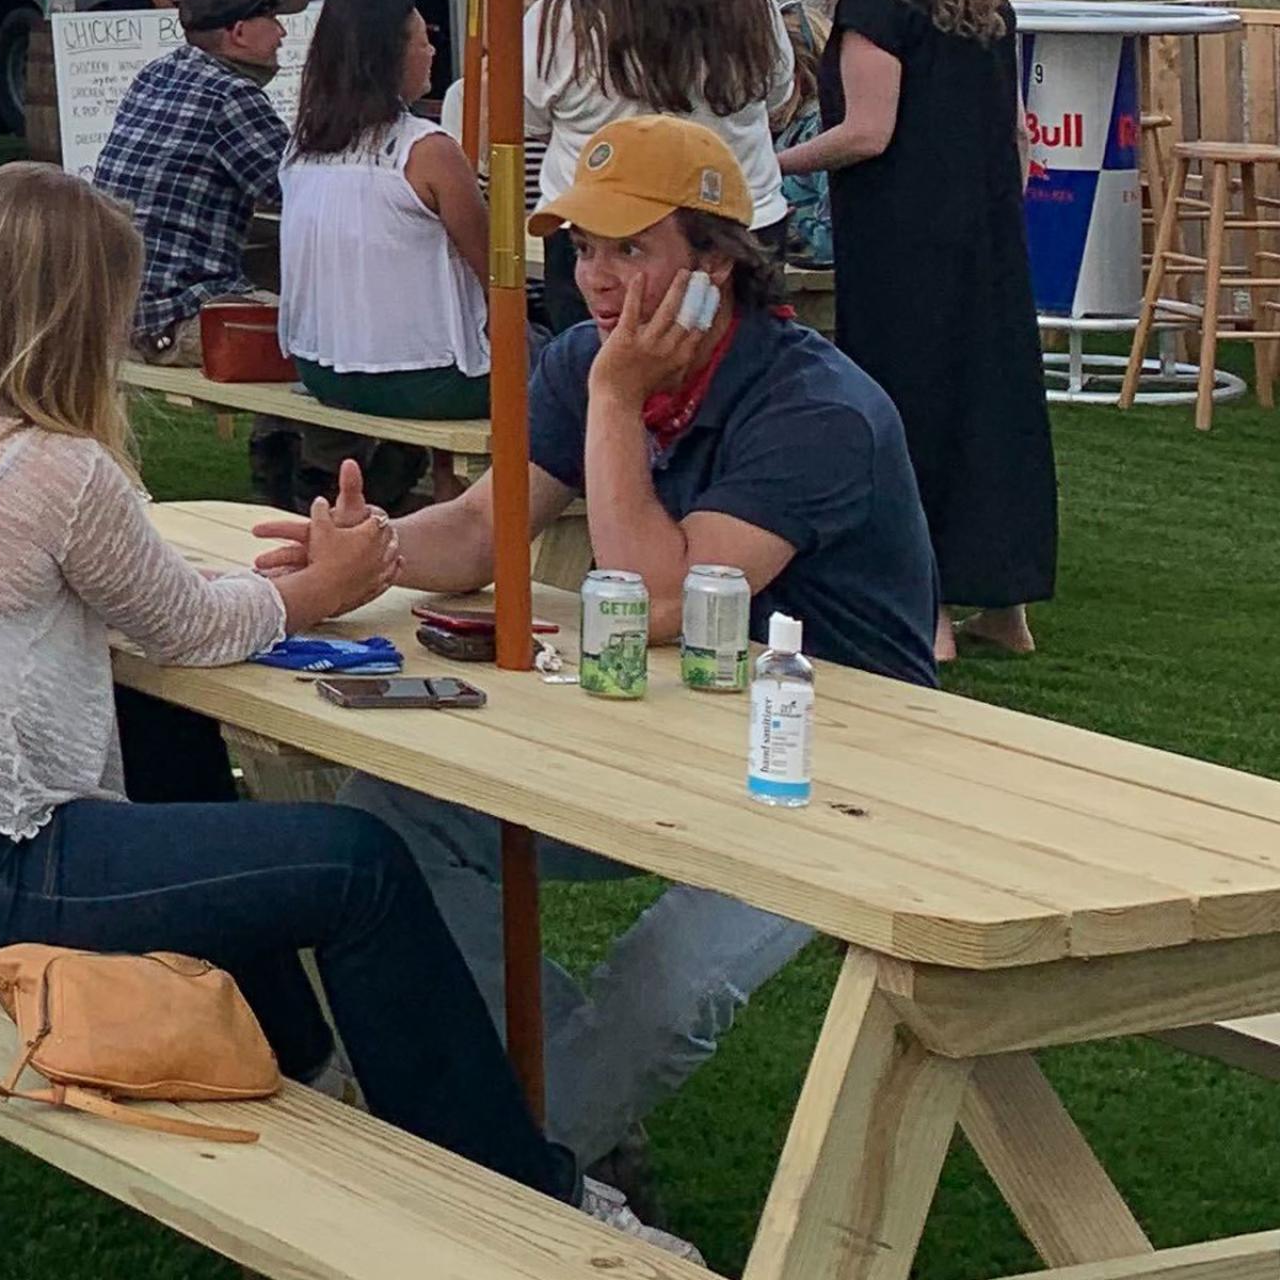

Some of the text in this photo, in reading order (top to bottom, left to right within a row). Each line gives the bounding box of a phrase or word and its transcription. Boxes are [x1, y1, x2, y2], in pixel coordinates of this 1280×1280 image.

[63, 18, 142, 49] CHICKEN
[159, 17, 185, 41] BO
[1034, 63, 1044, 84] 9
[1024, 112, 1083, 148] Bull
[761, 695, 773, 744] sanitizer
